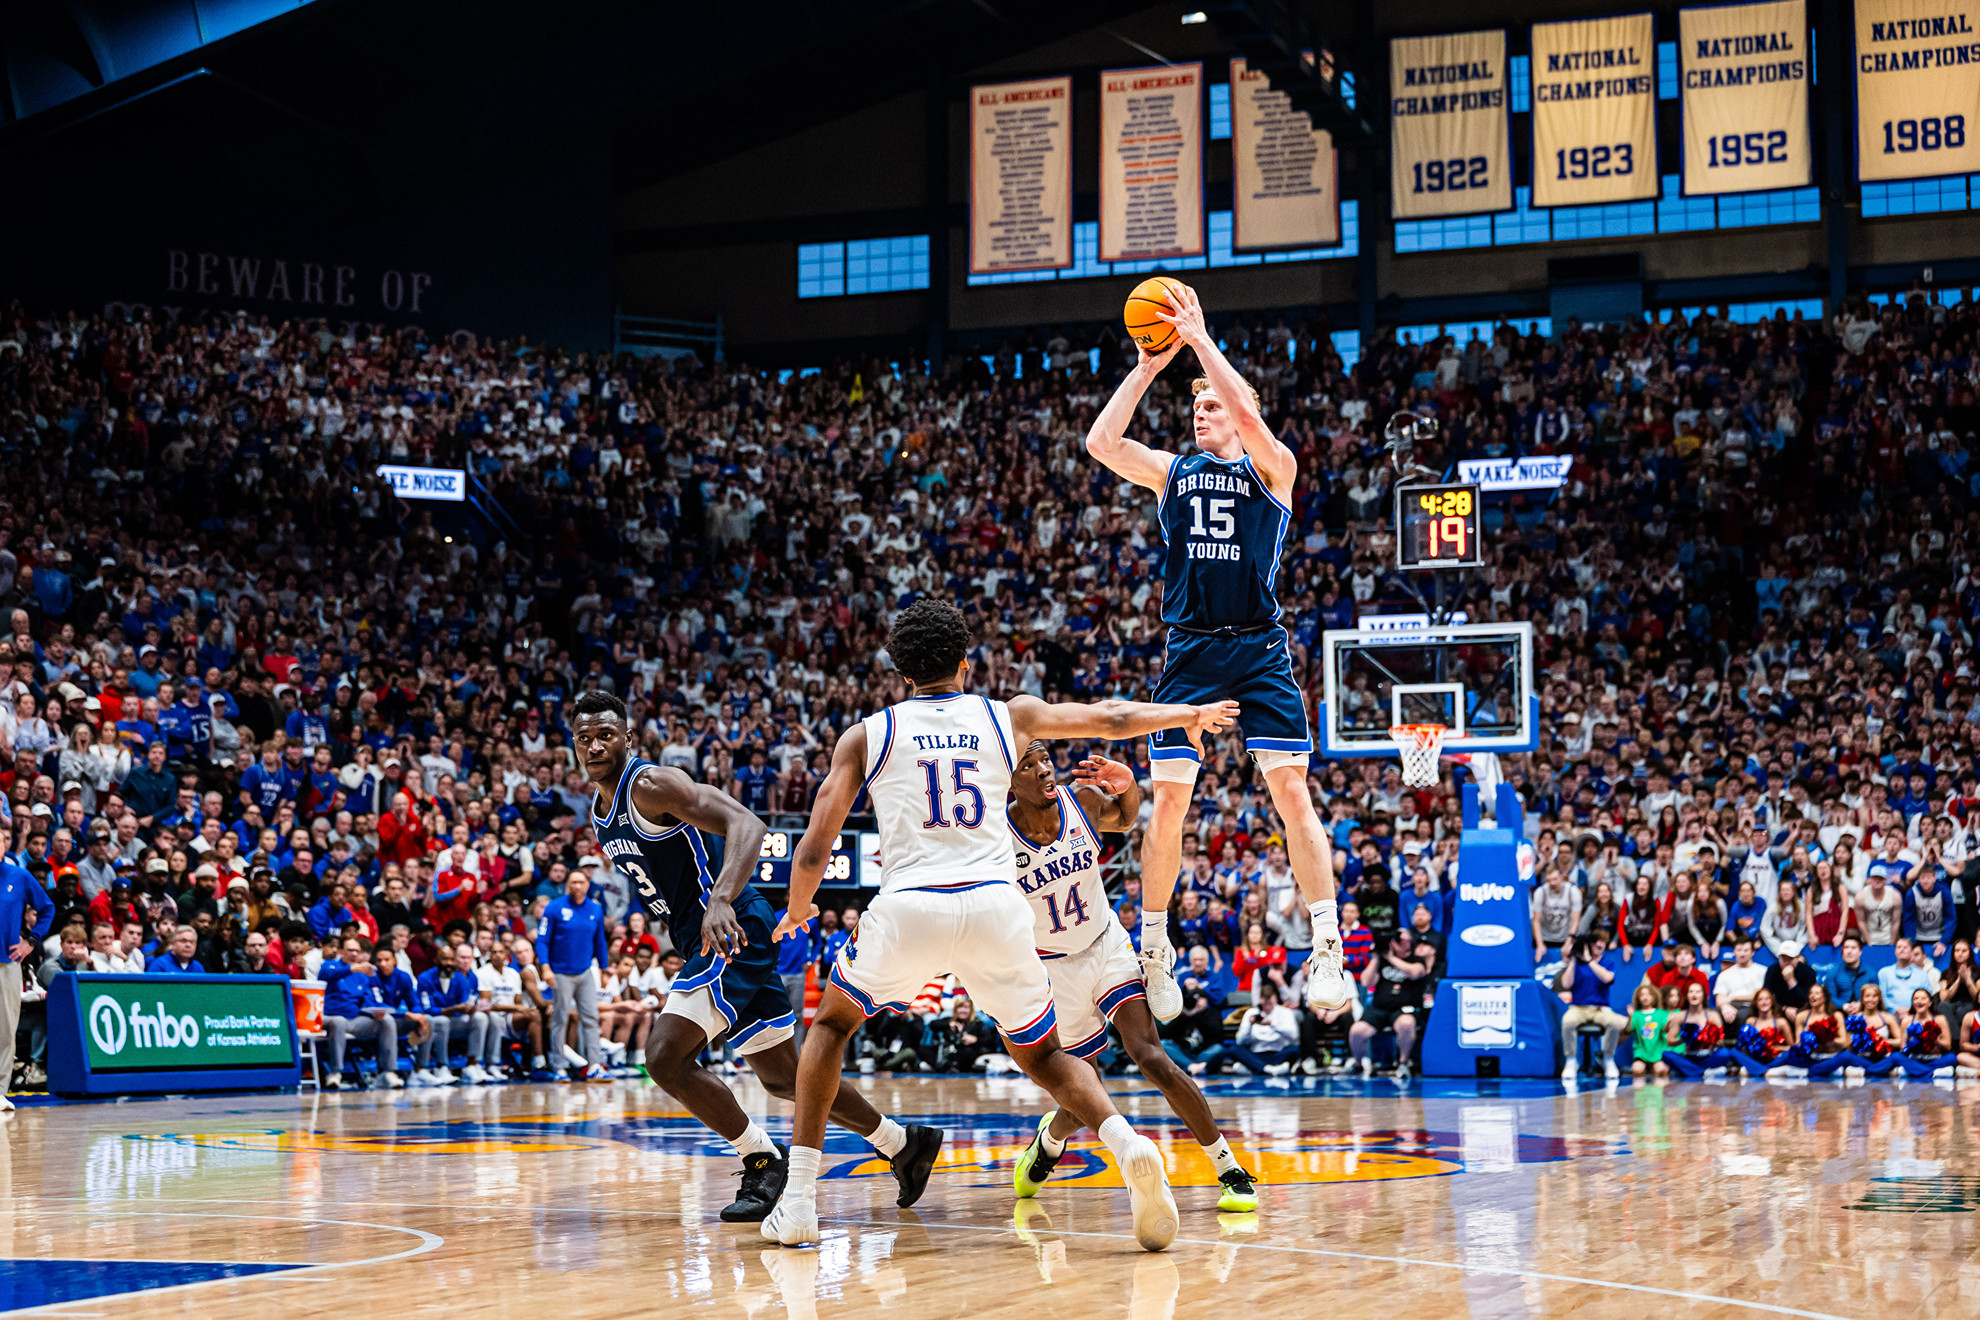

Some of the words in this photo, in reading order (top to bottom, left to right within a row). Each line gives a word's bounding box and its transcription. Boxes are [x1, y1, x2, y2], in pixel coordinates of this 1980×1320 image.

[1871, 15, 1973, 42] NATIONAL
[1697, 32, 1793, 59] NATIONAL
[1547, 47, 1640, 72] NATIONAL
[1859, 44, 1980, 75] CHAMPIONS
[1107, 73, 1195, 93] ALL-AMERICANS
[1405, 60, 1493, 87] NATIONAL
[1686, 61, 1804, 90] CHAMPIONS
[979, 86, 1065, 106] ALL-AMERICANS
[1537, 75, 1650, 103] CHAMPIONS
[1392, 89, 1504, 117] CHAMPIONS
[1883, 115, 1965, 154] 1988
[1556, 143, 1634, 181] 1923
[1708, 130, 1788, 168] 1952
[1413, 156, 1489, 194] 1922
[166, 248, 357, 308] BEWARE
[380, 269, 433, 314] OF
[413, 473, 456, 492] NOISE
[1177, 473, 1251, 498] BRIGHAM
[1468, 465, 1514, 483] MAKE
[1518, 463, 1563, 480] NOISE
[1190, 495, 1235, 539] 15
[1420, 490, 1472, 517] 4:28
[1428, 516, 1467, 558] 19
[1186, 542, 1241, 561] YOUNG
[913, 734, 980, 752] TILLER
[917, 758, 987, 830] 15
[601, 838, 645, 860] RIGHAM
[759, 832, 788, 858] 28
[1016, 850, 1093, 895] KANSAS
[1041, 881, 1091, 935] 14
[129, 1001, 200, 1048] fnbo
[204, 1014, 229, 1029] Proud
[230, 1015, 250, 1029] Bank
[250, 1015, 281, 1029] Partner
[206, 1033, 216, 1046] of
[217, 1033, 246, 1046] Kansas
[247, 1033, 281, 1046] Athletics
